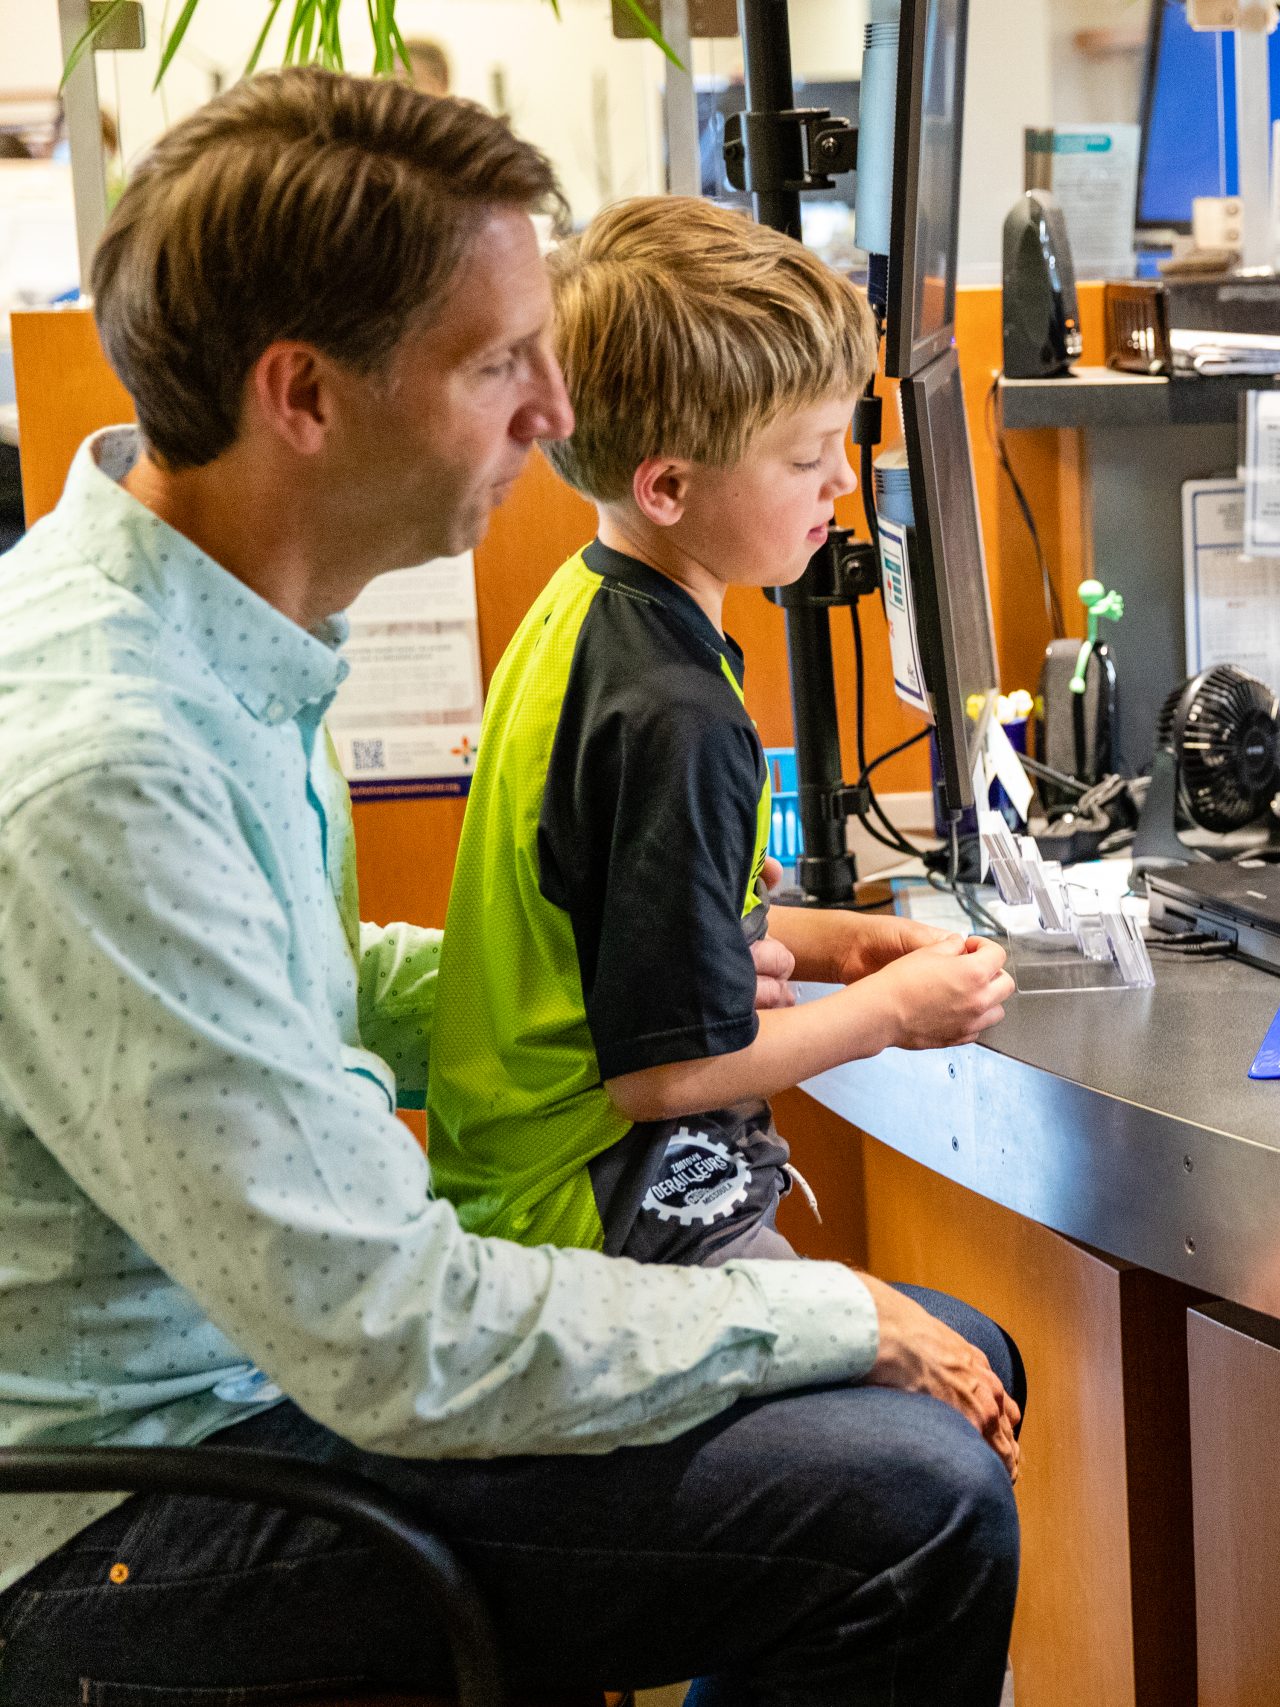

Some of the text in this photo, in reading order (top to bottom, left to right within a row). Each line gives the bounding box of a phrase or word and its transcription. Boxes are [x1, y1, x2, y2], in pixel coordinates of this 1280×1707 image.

[670, 1152, 702, 1174] ZOOTOWN
[651, 1155, 728, 1200] DERAILLEURS
[702, 1182, 733, 1205] MISSOULA
